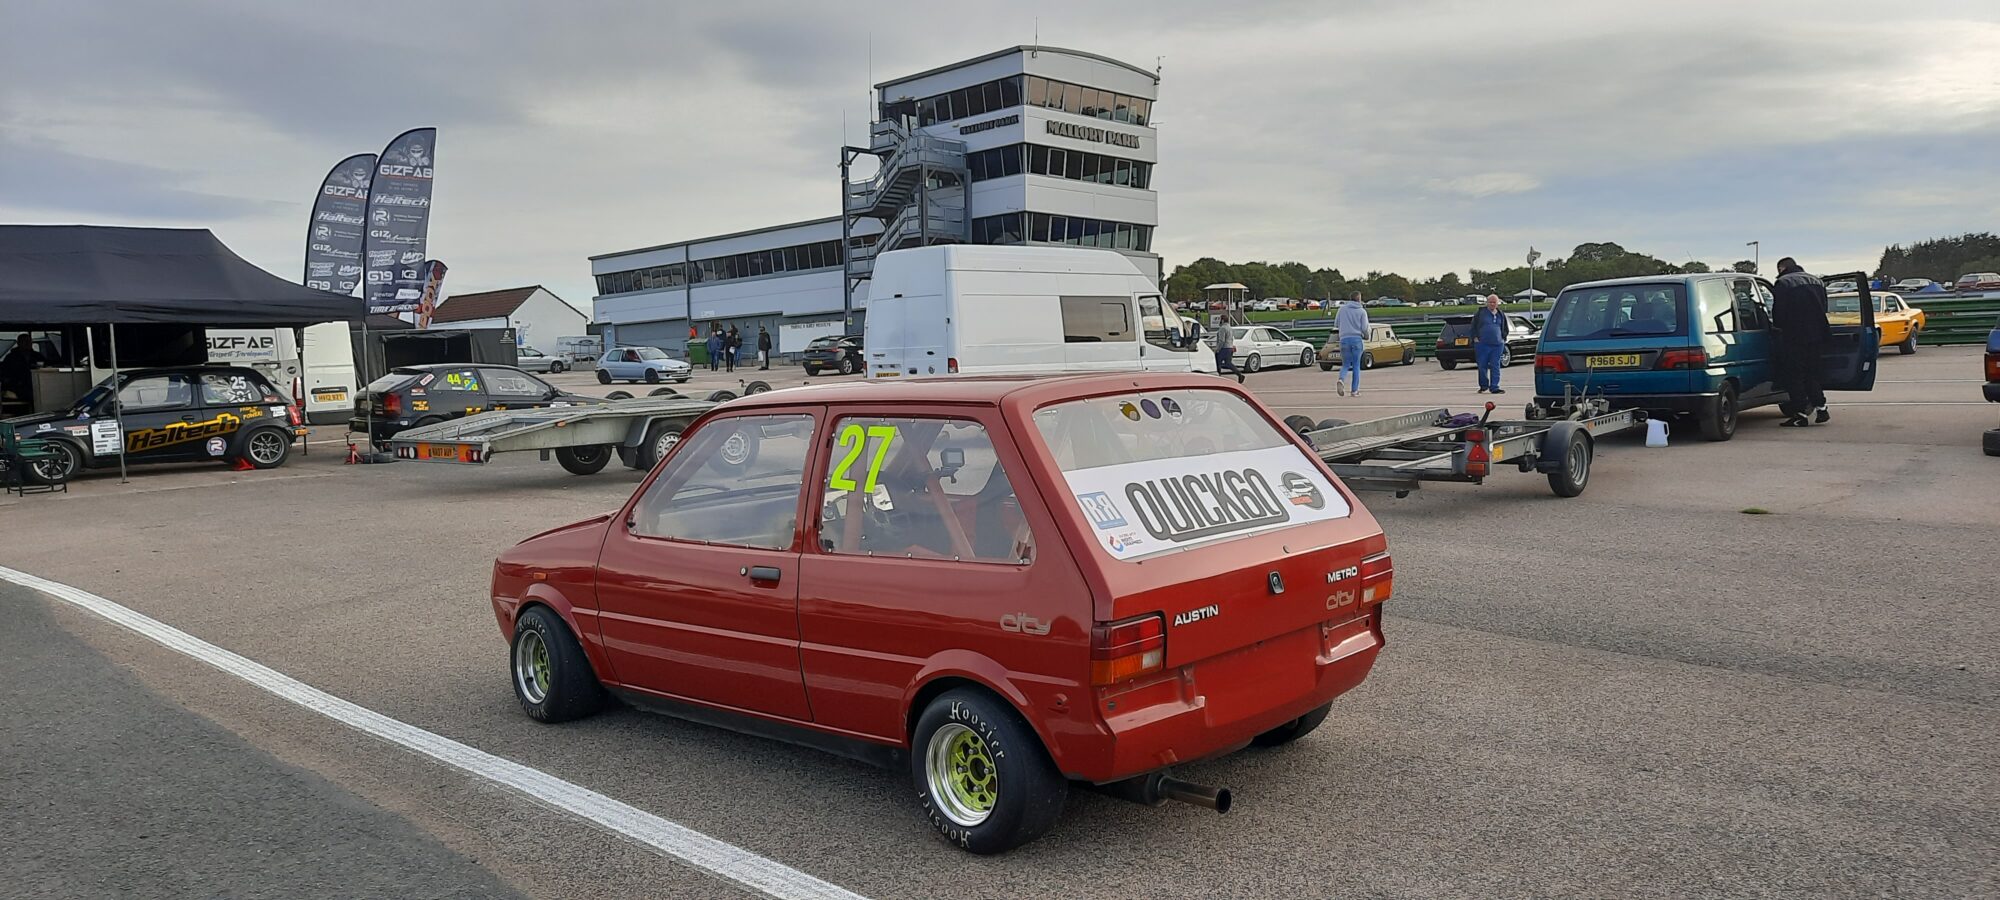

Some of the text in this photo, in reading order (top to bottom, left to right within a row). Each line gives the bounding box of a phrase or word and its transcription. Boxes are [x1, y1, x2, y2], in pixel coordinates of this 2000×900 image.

[960, 115, 1019, 135] MALLORY PARK
[1046, 120, 1140, 149] MALLORY PARK
[380, 164, 433, 179] GIZFAB
[324, 185, 368, 199] GIZFA
[373, 194, 429, 207] Haltech
[367, 271, 393, 281] G19
[1590, 356, 1616, 366] R968
[230, 376, 247, 389] 25
[447, 373, 461, 385] 44
[128, 414, 239, 452] Haltech
[830, 424, 896, 494] 27
[1125, 468, 1290, 543] QUICK60
[1326, 565, 1358, 583] METRO
[1000, 612, 1051, 636] city
[1173, 604, 1219, 627] AUSTIN
[949, 701, 1005, 759] Hoosier
[918, 791, 973, 849] Hoosier
